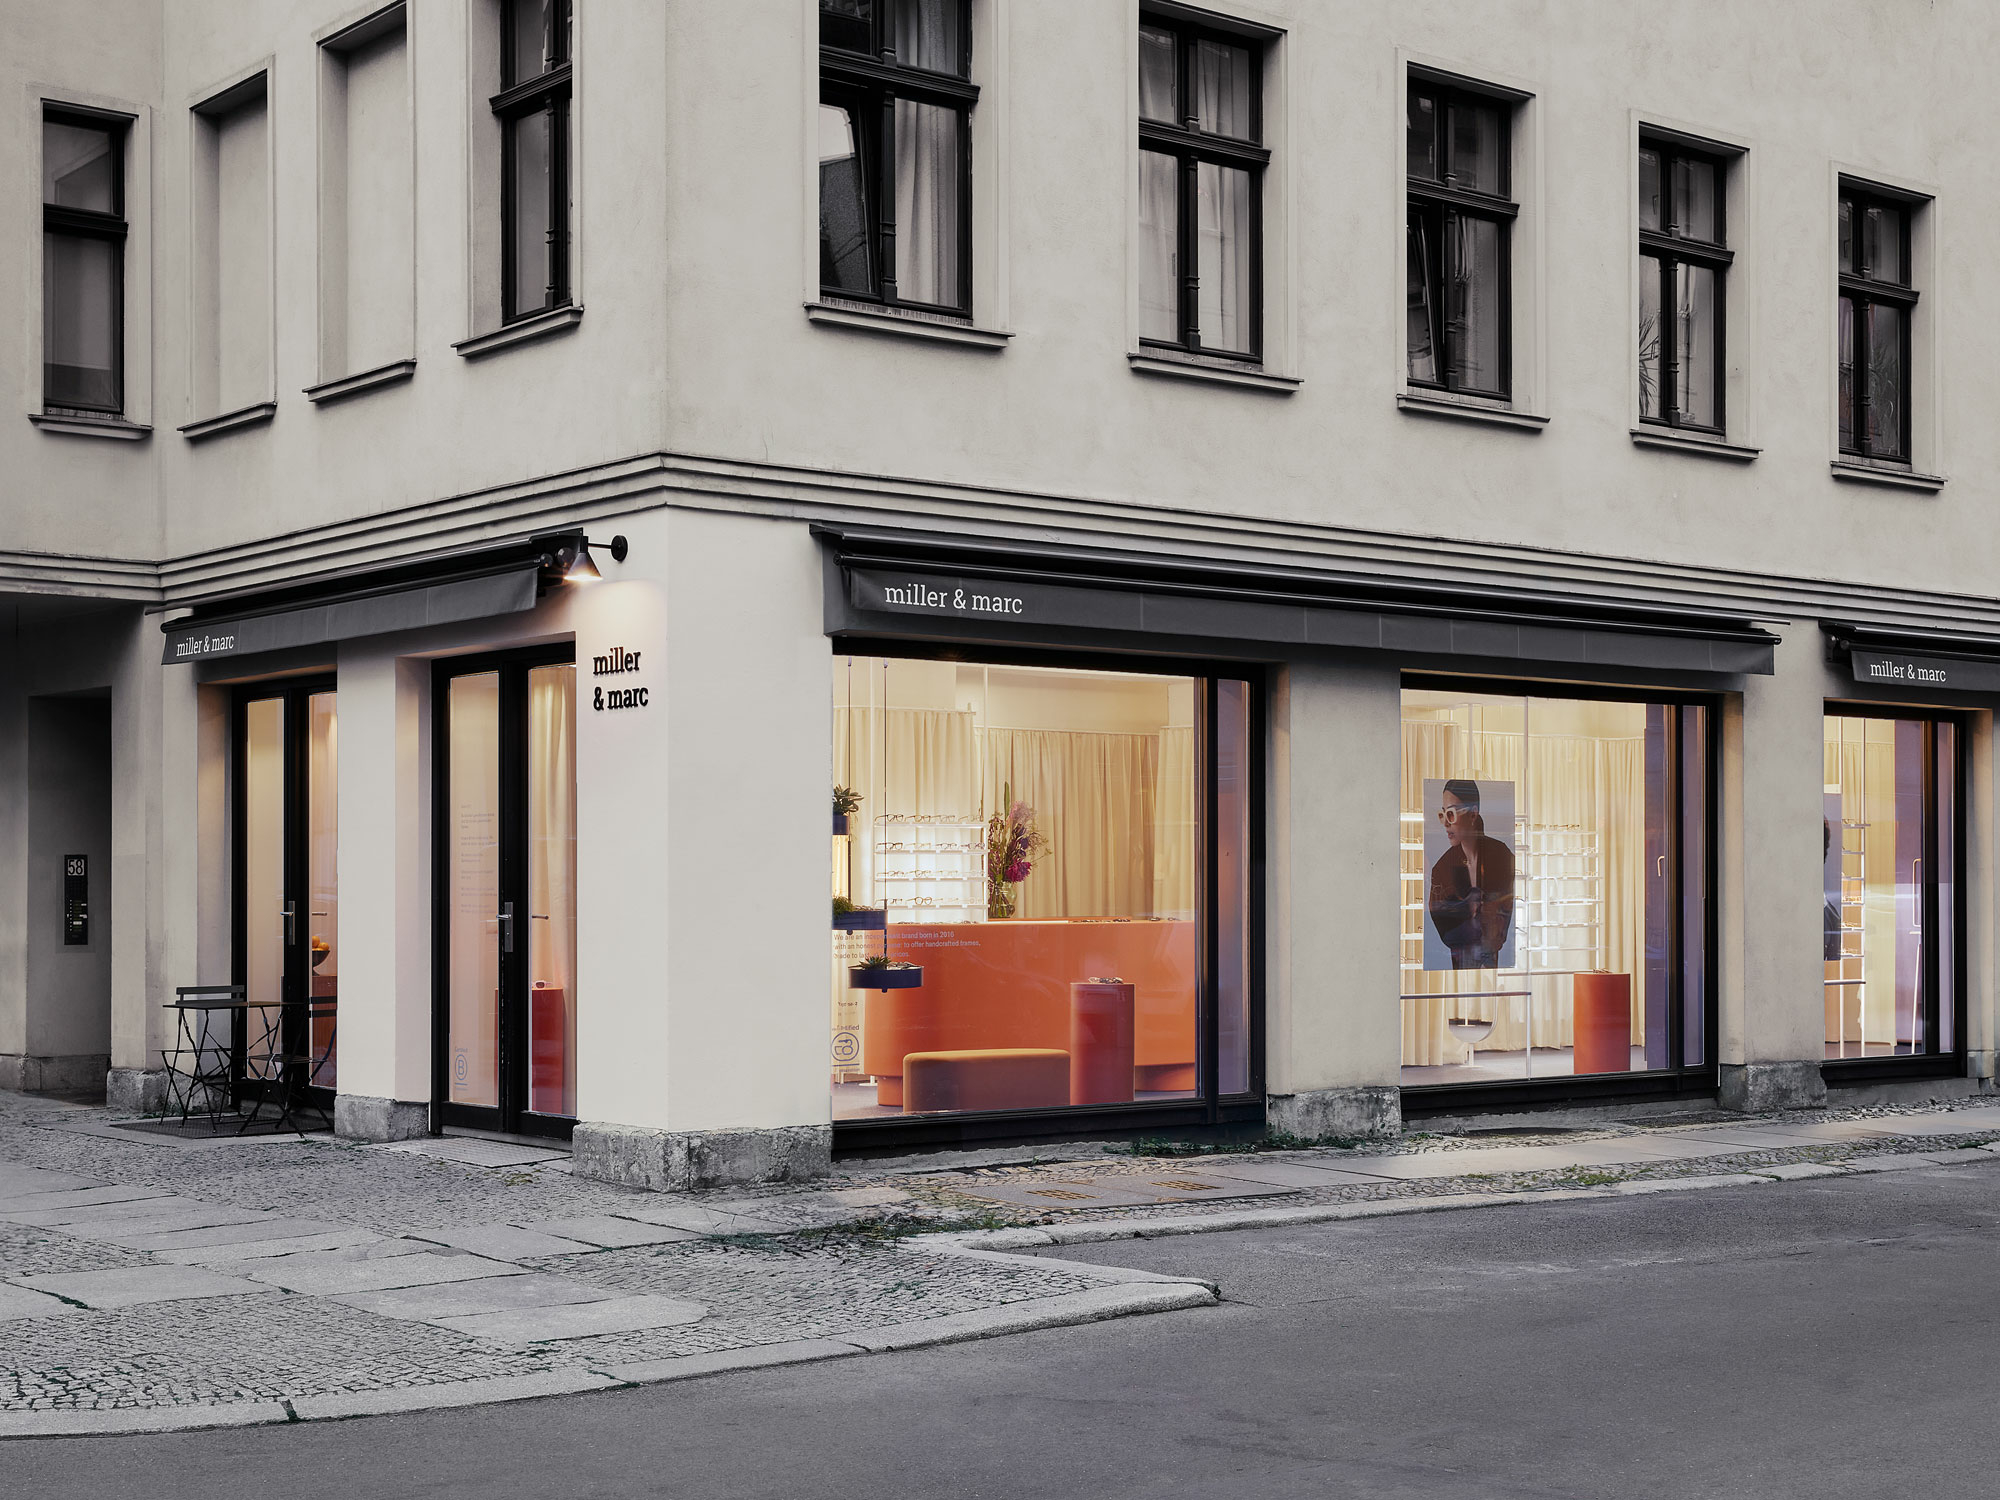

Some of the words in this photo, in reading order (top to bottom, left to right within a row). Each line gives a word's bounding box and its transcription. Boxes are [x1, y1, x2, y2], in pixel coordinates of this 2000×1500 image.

[885, 583, 948, 608] miller
[953, 588, 966, 609] &
[971, 594, 1023, 614] marc
[176, 637, 202, 657] miller
[203, 635, 210, 653] &
[211, 635, 234, 652] marc
[593, 646, 641, 675] miller
[1870, 661, 1905, 679] miller
[1907, 664, 1915, 680] &
[1917, 668, 1946, 682] marc
[593, 686, 604, 711] &
[607, 687, 649, 710] marc
[68, 860, 83, 875] 58
